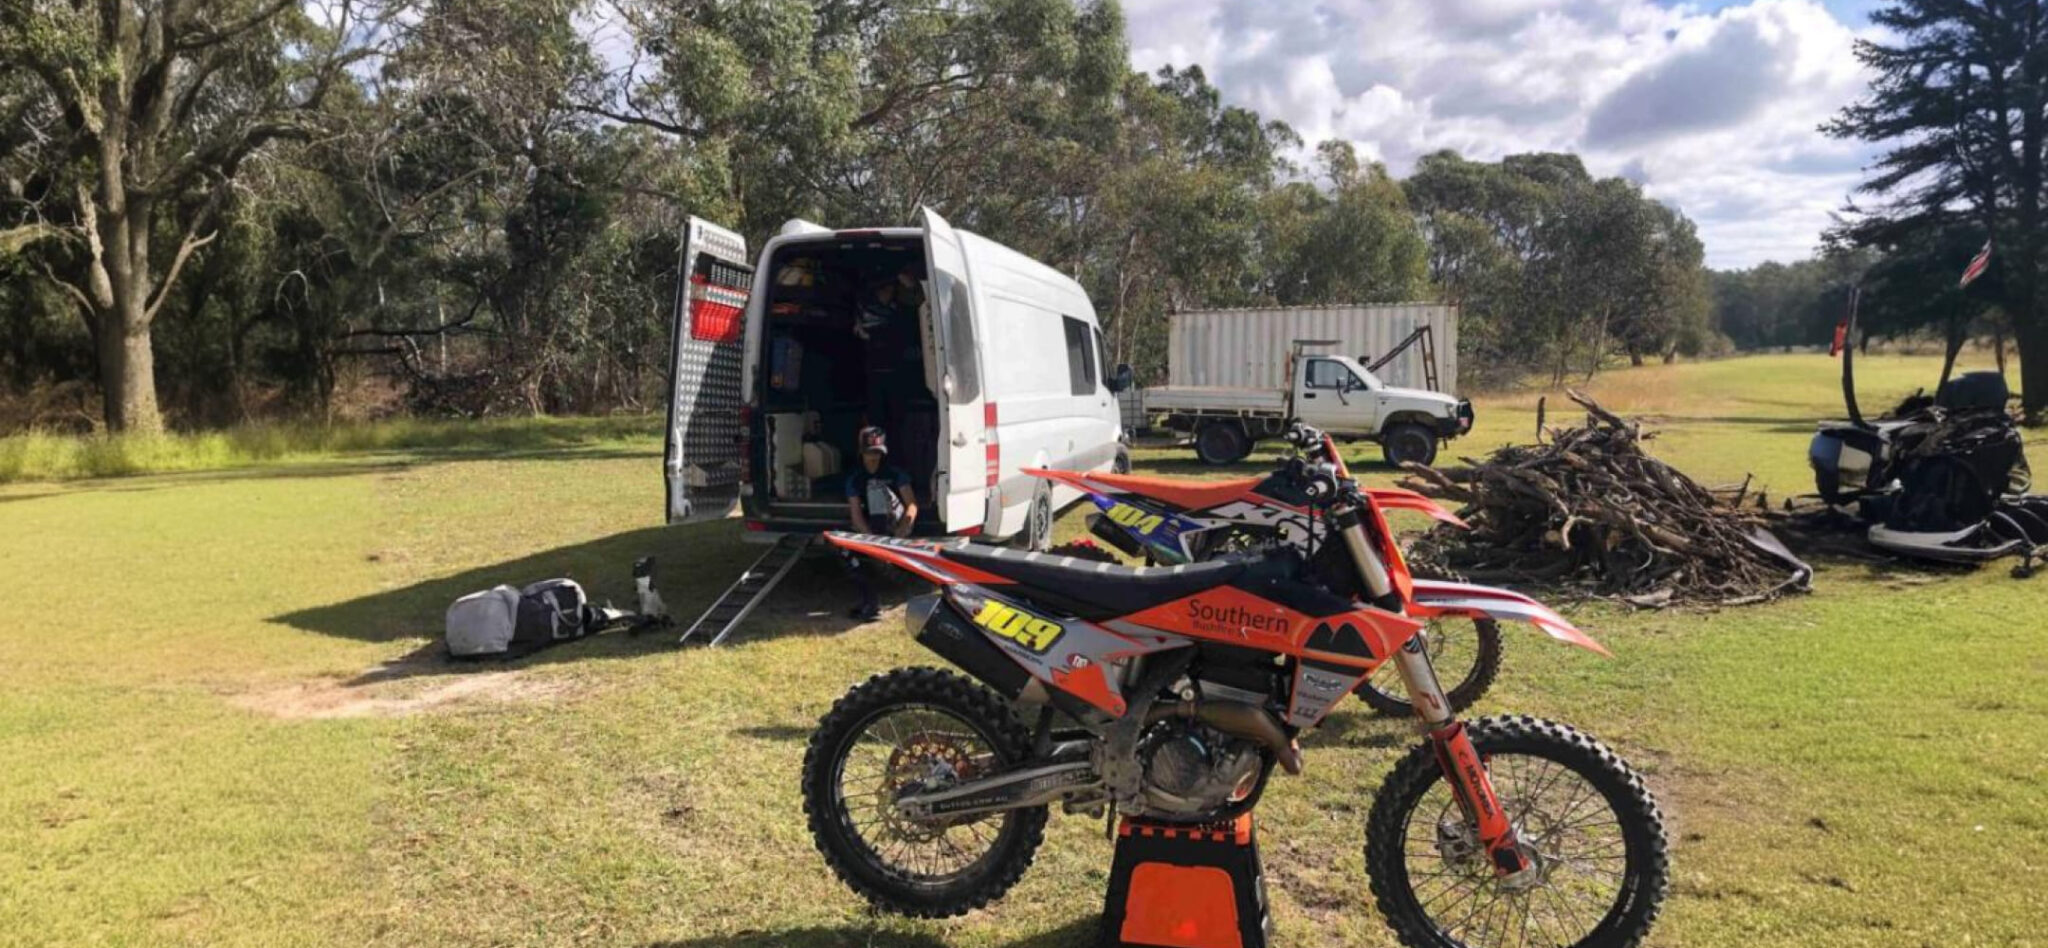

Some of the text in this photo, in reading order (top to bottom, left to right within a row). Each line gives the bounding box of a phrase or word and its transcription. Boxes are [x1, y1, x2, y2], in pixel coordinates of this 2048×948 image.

[1107, 501, 1163, 535] 104
[973, 599, 1063, 651] 109
[1188, 599, 1289, 634] Southern
